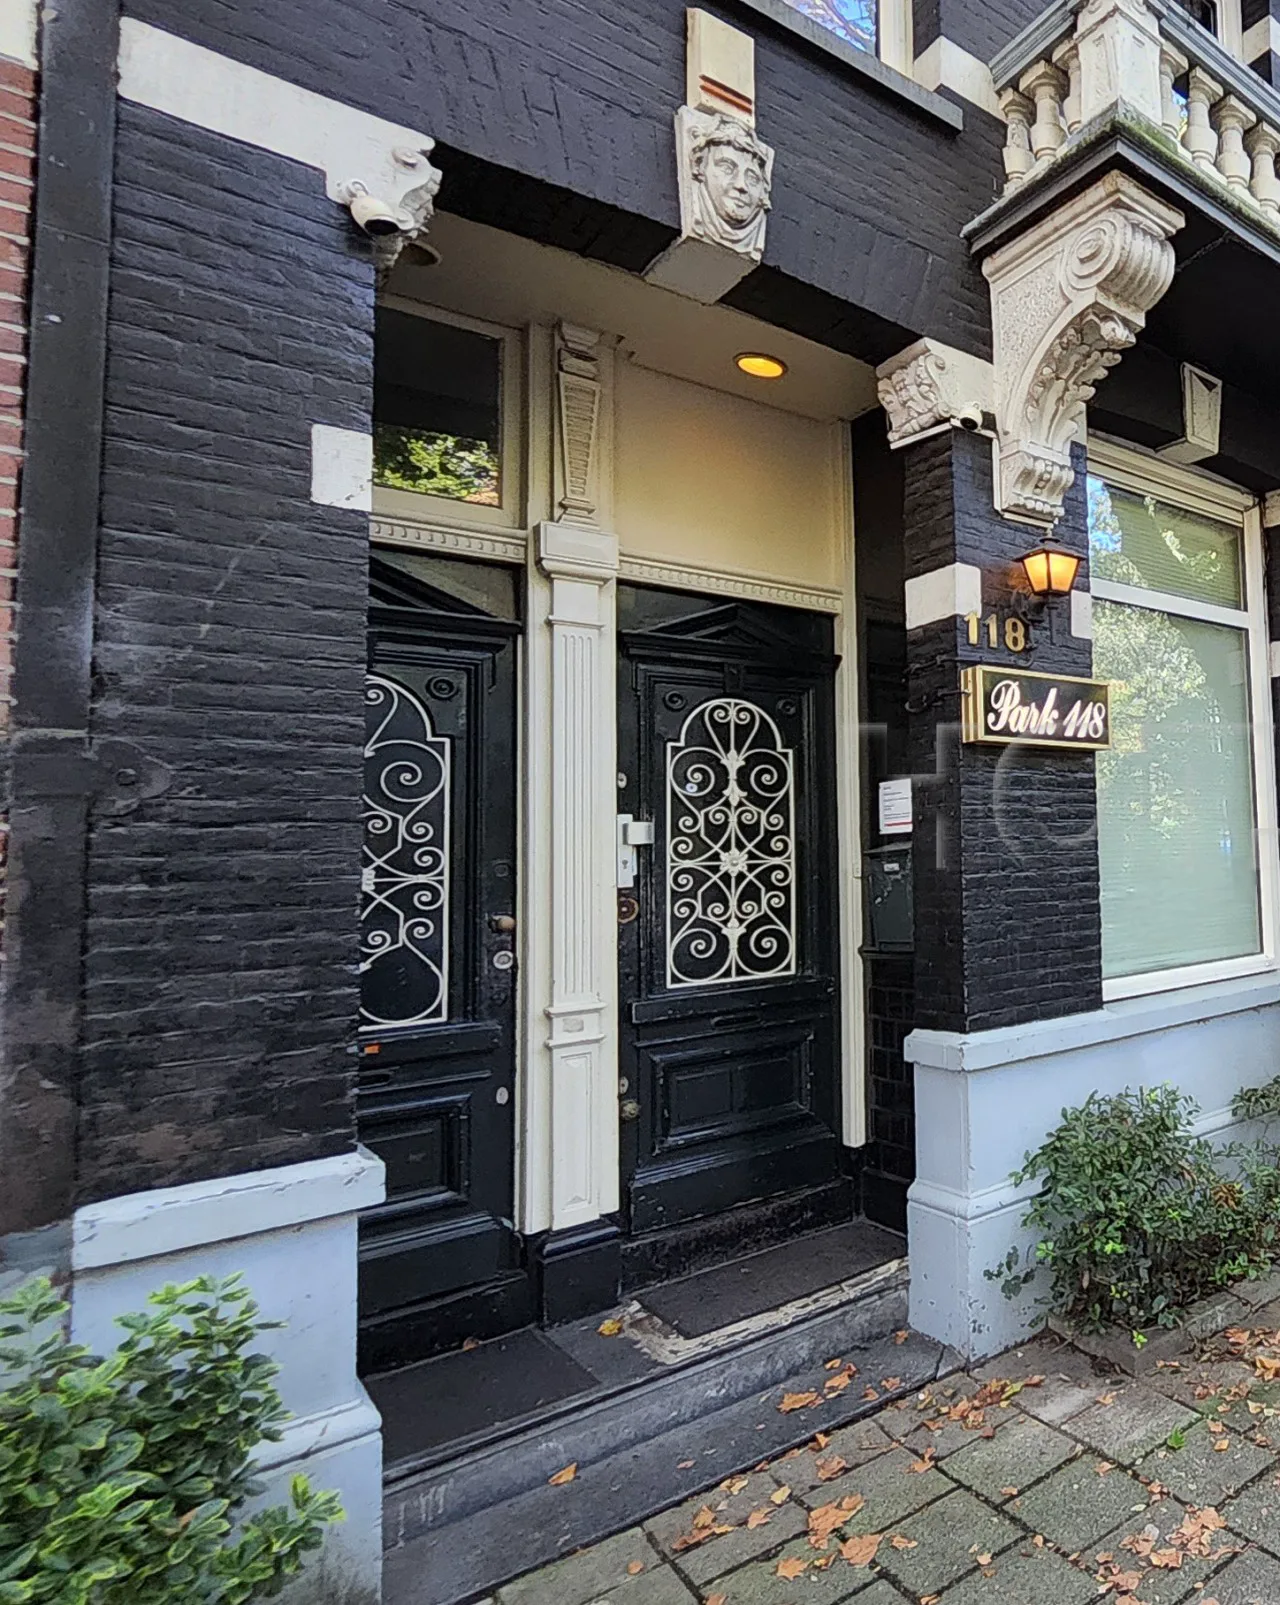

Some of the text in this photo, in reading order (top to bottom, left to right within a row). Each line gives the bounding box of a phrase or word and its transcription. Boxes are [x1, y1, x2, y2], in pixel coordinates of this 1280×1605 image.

[963, 612, 1025, 651] 118
[987, 679, 1106, 739] Park 118
